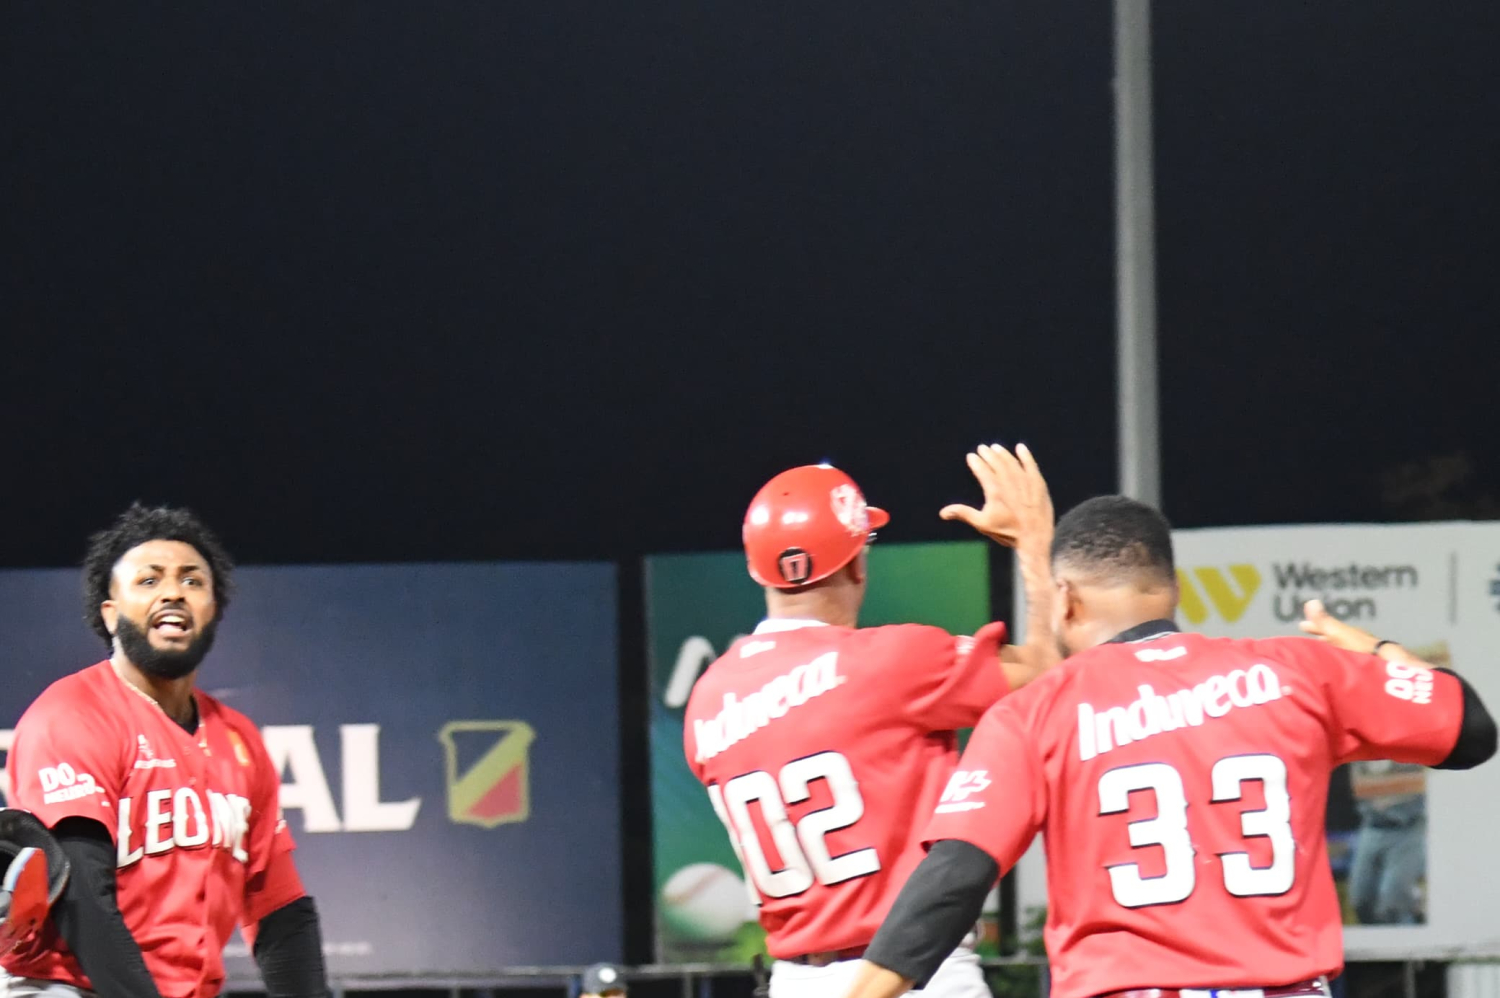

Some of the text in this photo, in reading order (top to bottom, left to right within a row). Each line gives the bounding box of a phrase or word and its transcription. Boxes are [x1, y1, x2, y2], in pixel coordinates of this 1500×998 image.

[1272, 562, 1418, 591] Western
[1077, 662, 1291, 762] Induveca
[1097, 753, 1298, 908] 33
